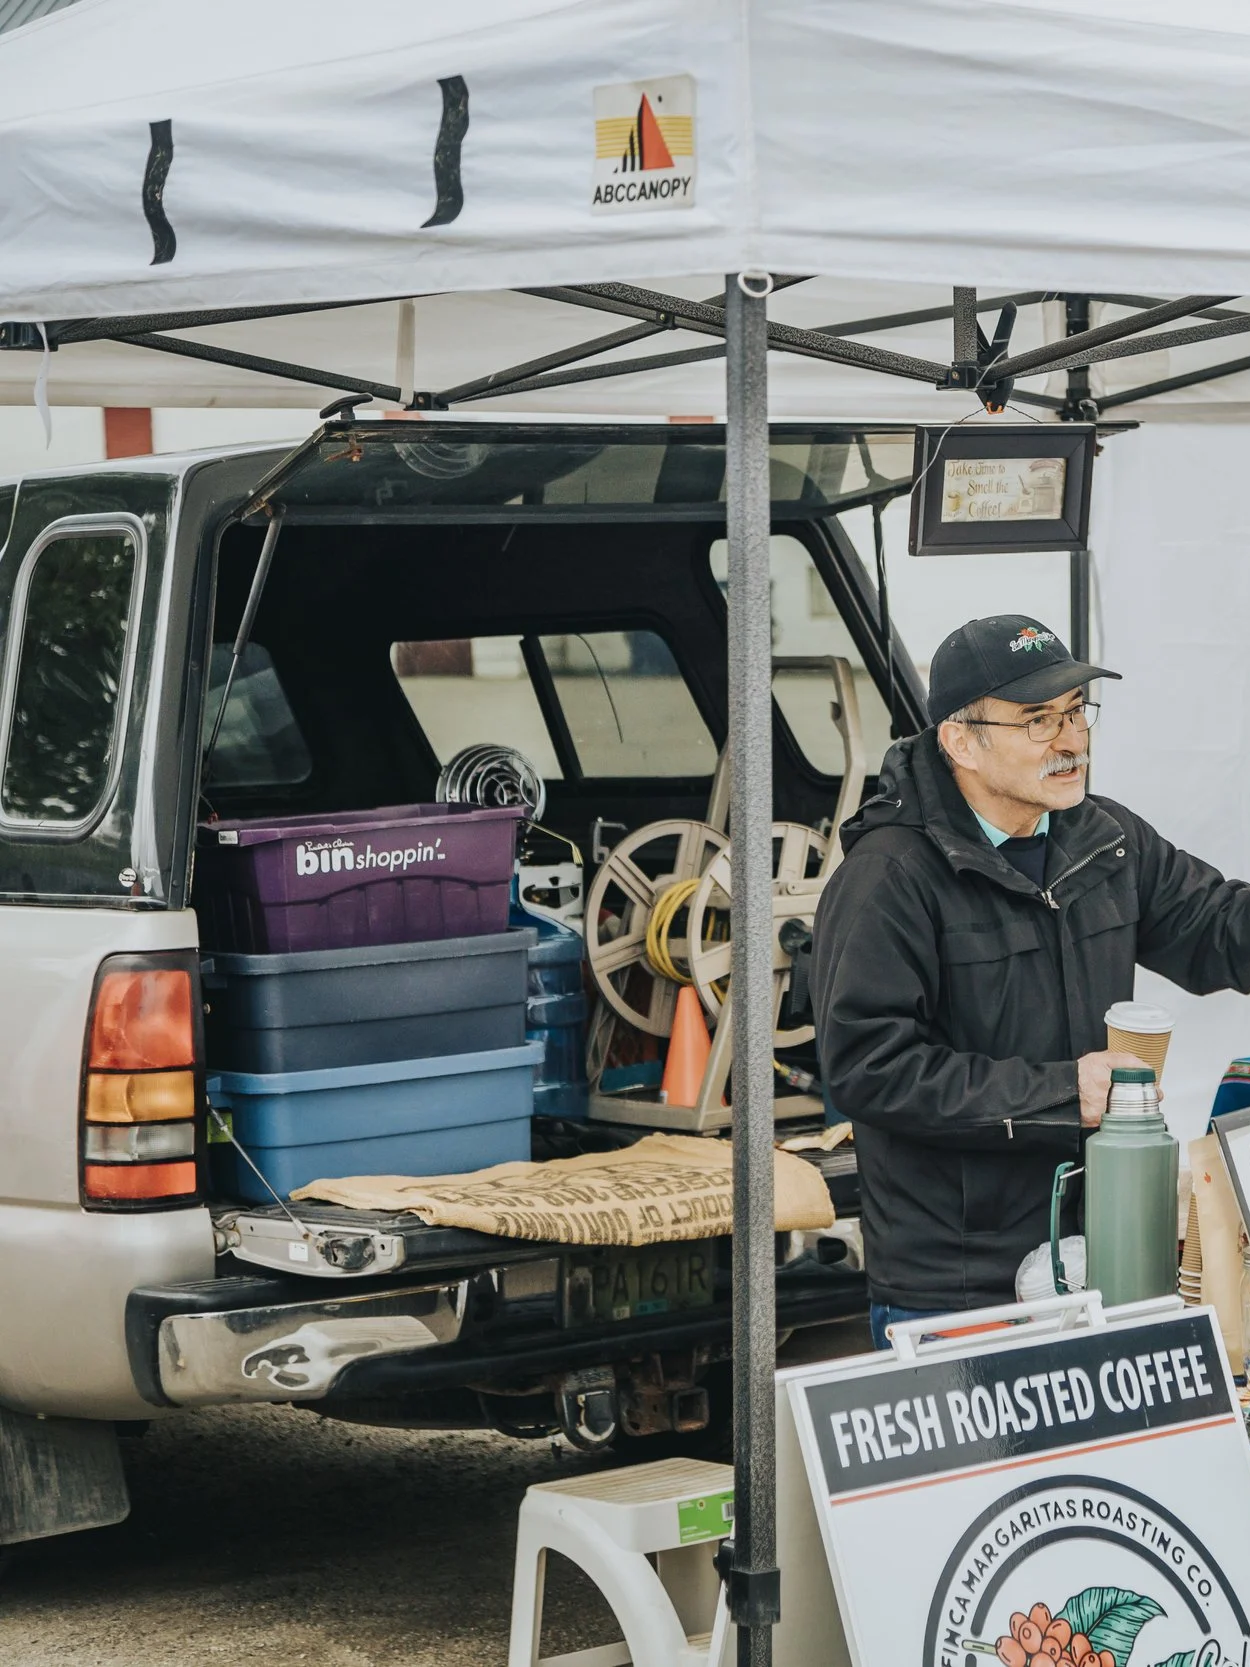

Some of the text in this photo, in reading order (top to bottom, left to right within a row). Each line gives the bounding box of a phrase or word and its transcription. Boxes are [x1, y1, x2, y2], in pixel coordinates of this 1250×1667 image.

[593, 176, 691, 205] ABCCANOPY
[947, 461, 973, 477] Take
[967, 479, 1009, 496] Smell the
[296, 838, 442, 876] bin shoppin'
[639, 1204, 665, 1230] OF
[830, 1344, 1213, 1469] FRESH ROASTED COFFEE
[940, 1498, 1213, 1667] FINCA MARGARITAS ROASTING CO.
